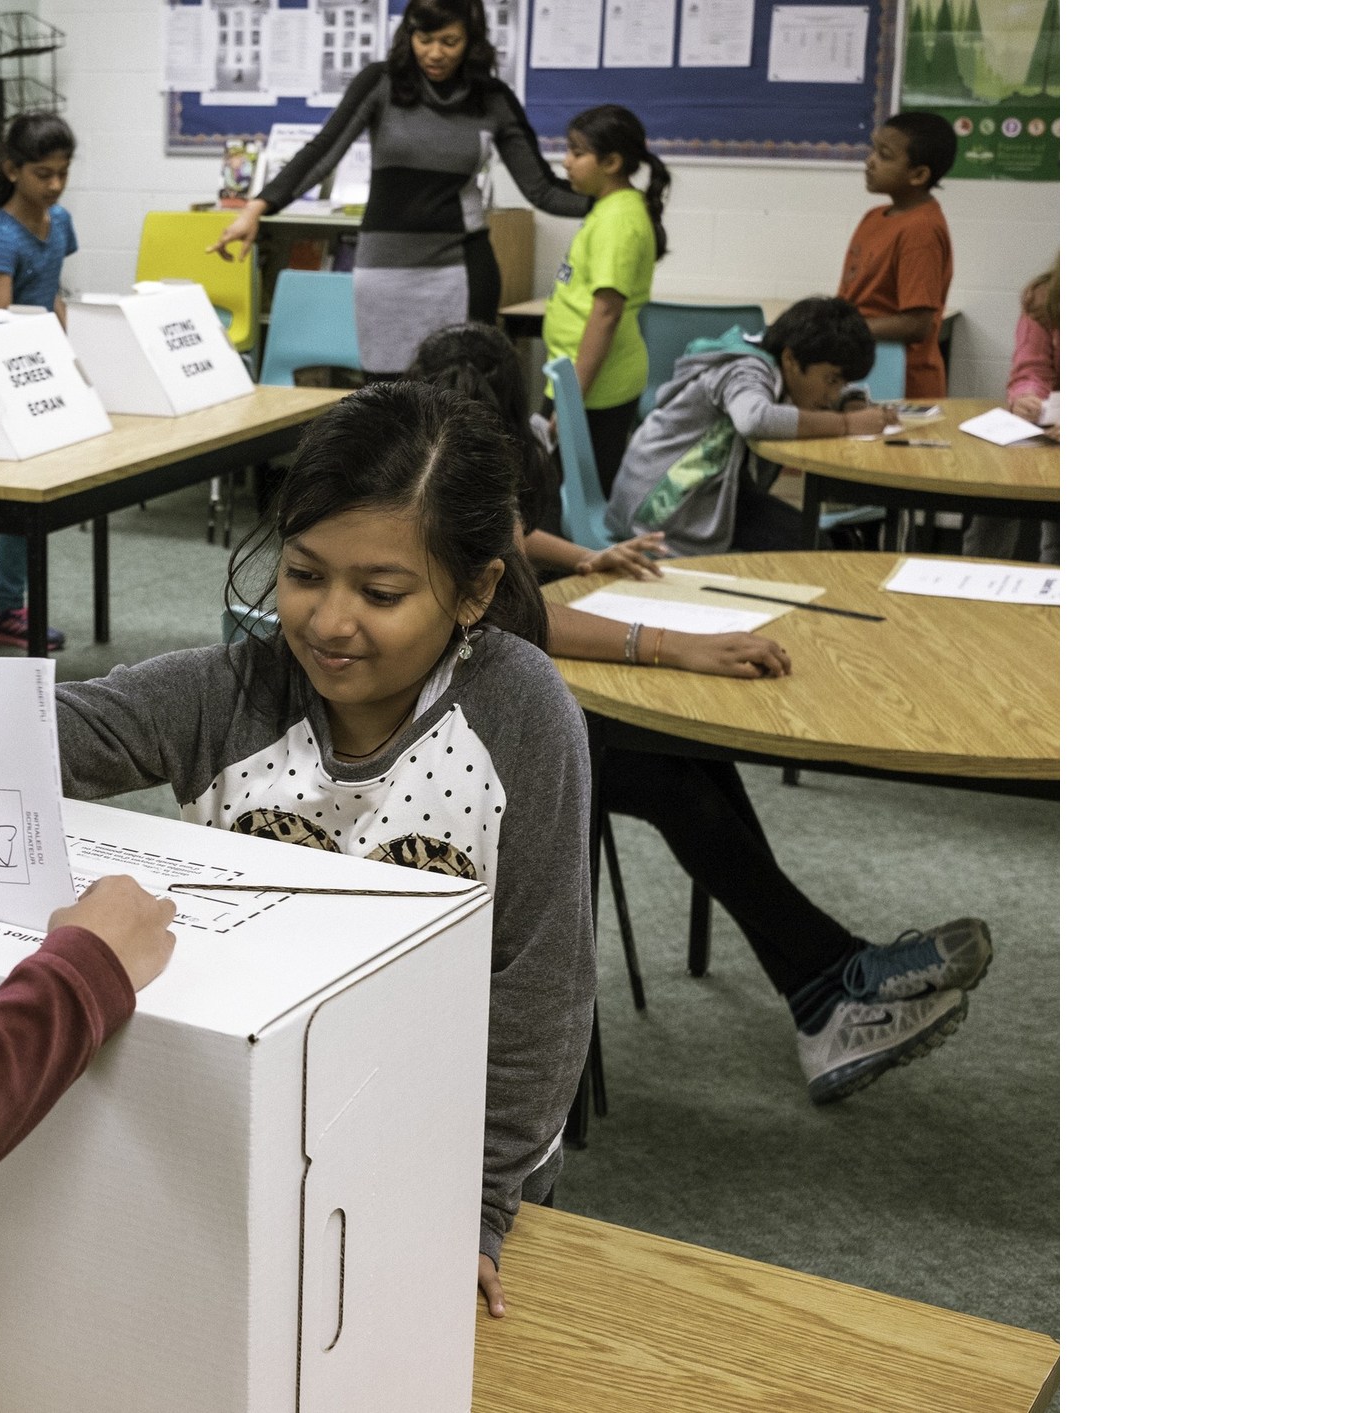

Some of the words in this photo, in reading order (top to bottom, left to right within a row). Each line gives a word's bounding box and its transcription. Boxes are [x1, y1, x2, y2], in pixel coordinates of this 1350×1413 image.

[161, 319, 195, 337] VOTING
[166, 333, 202, 351] SCREEN
[2, 351, 46, 372] VOTING
[10, 366, 54, 388] SCREEN
[25, 811, 36, 865] SCRUTATEUR
[33, 811, 42, 854] INITIALES
[38, 854, 44, 866] DU
[3, 930, 45, 946] allot
